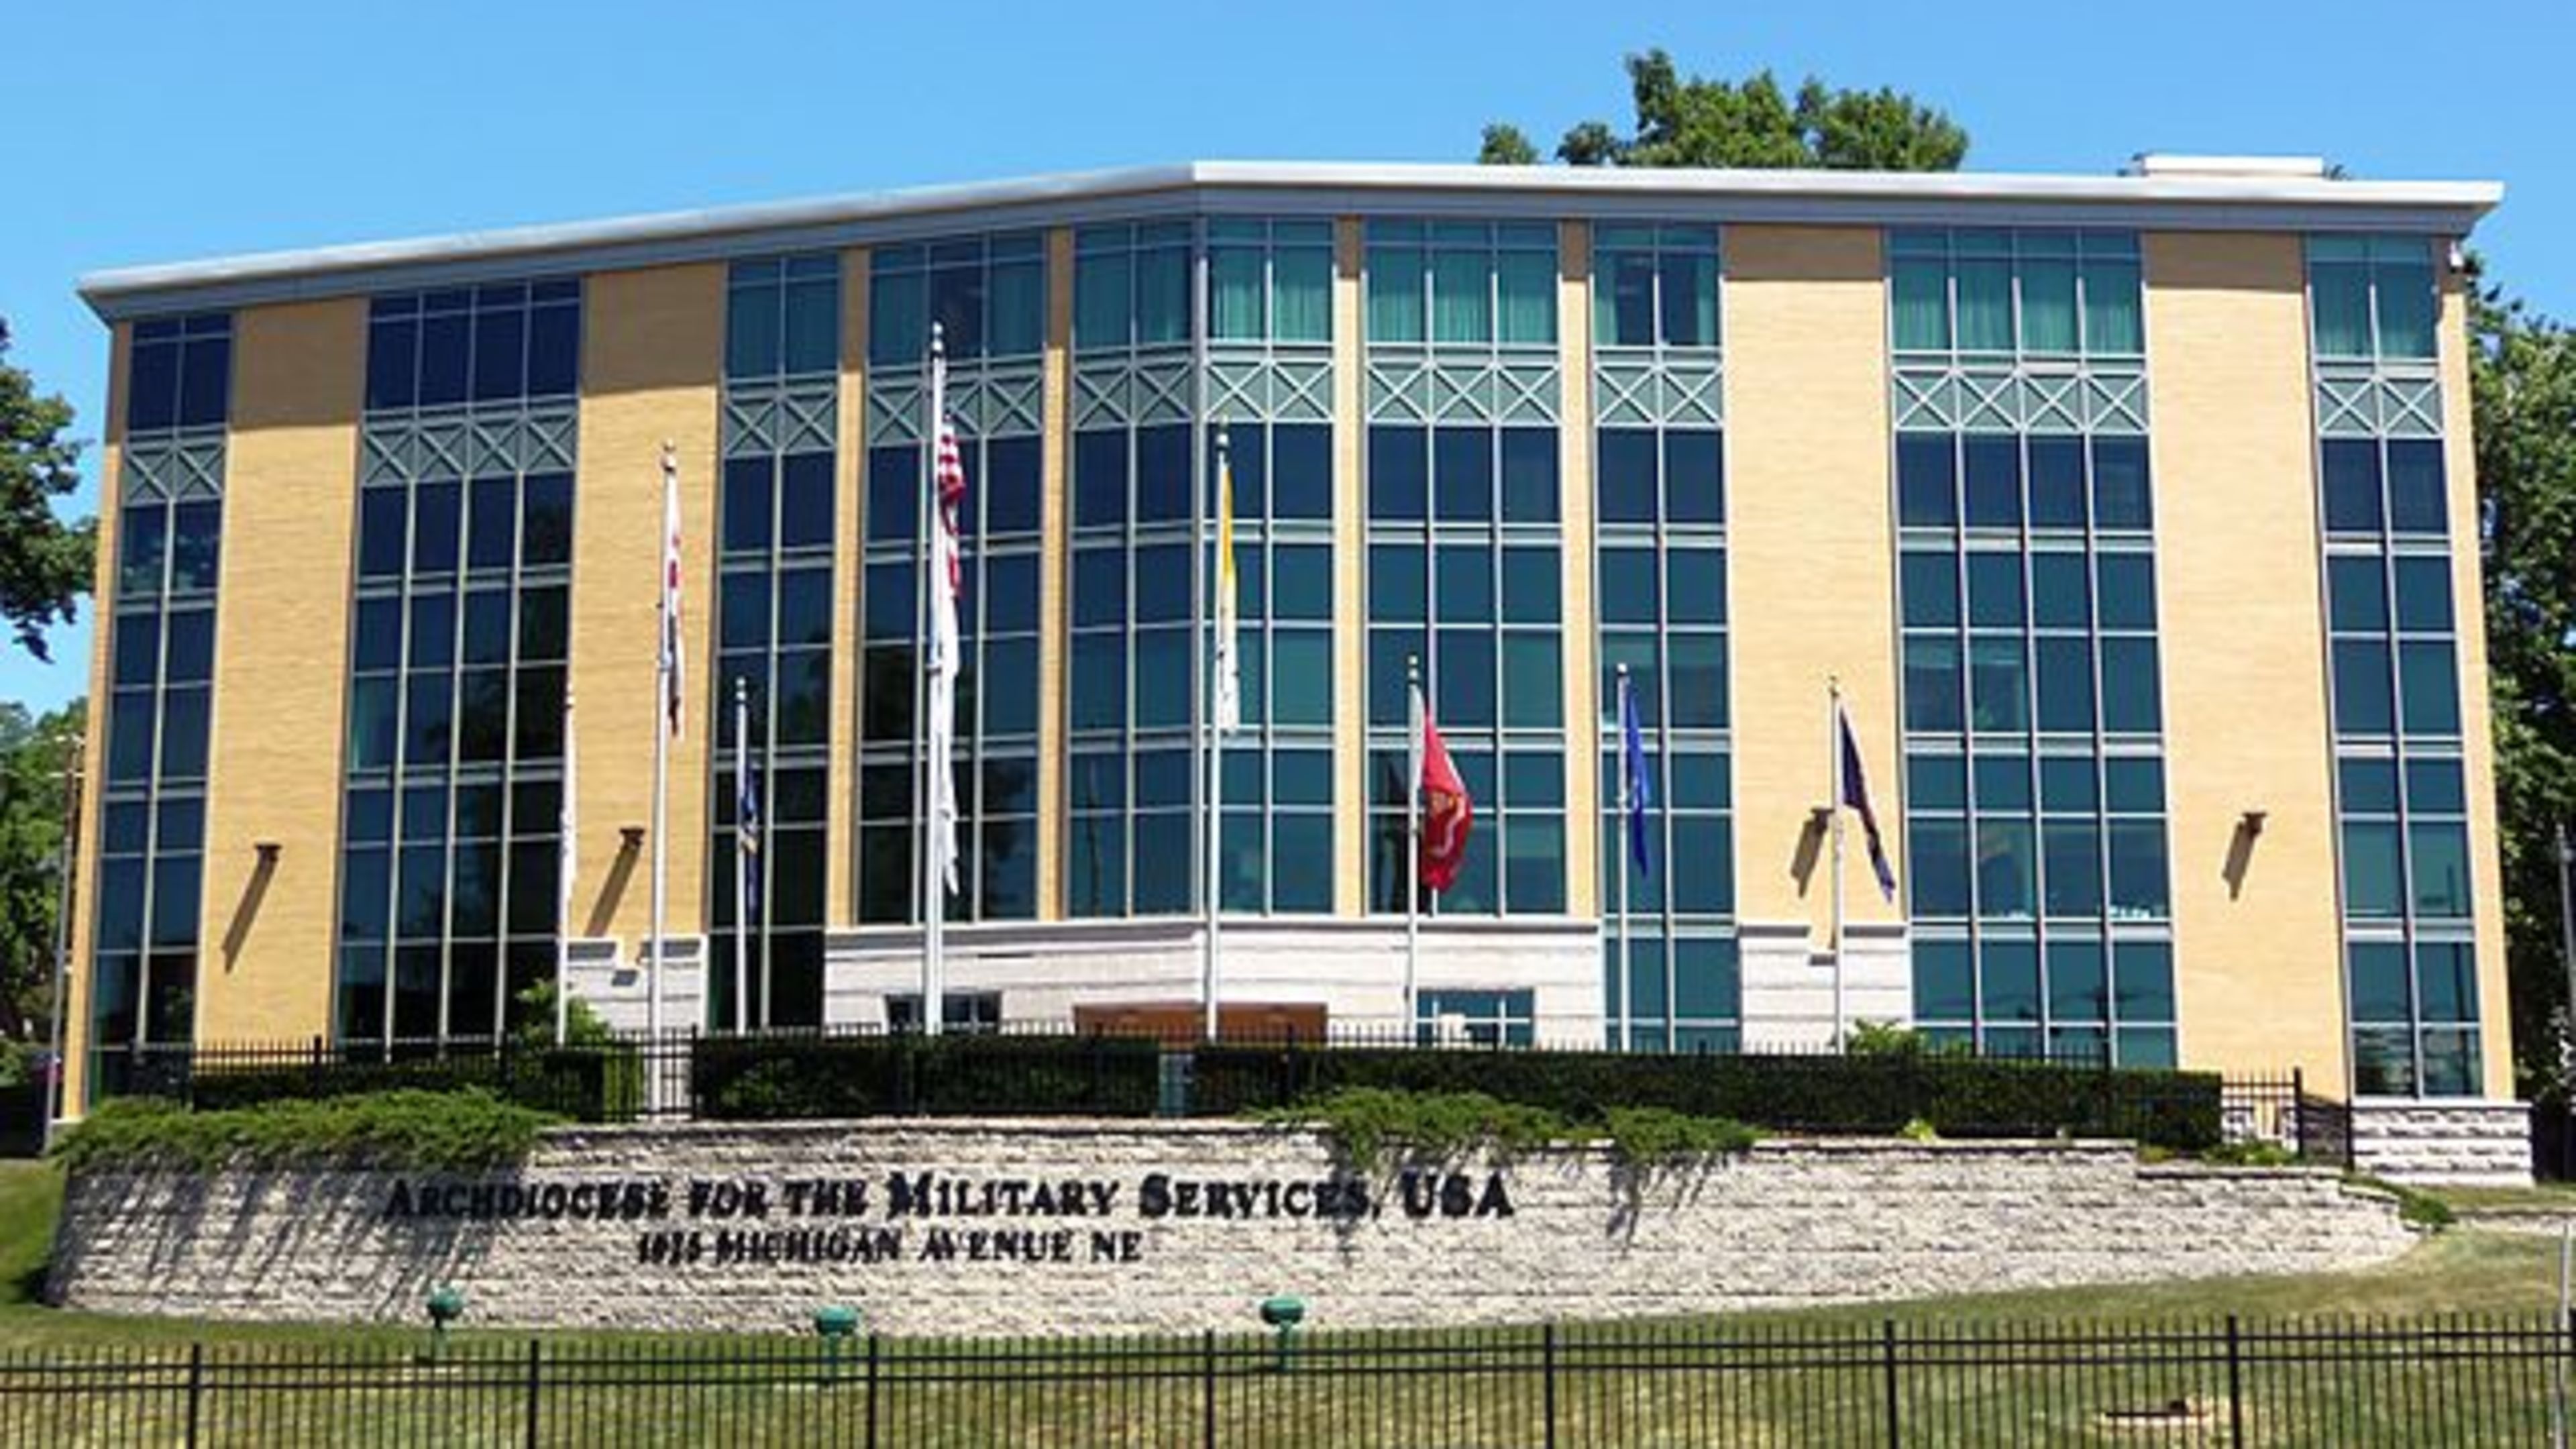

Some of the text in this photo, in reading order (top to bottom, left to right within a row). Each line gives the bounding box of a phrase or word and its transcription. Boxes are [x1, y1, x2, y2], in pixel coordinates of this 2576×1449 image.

[688, 1179, 771, 1218] FOR
[784, 1179, 869, 1217] THE
[885, 1171, 1119, 1219] MILITARY
[1401, 1171, 1513, 1219] USA
[715, 1228, 902, 1265] MICHIGAN
[918, 1226, 1073, 1262] AVENUE
[1089, 1229, 1140, 1263] NE
